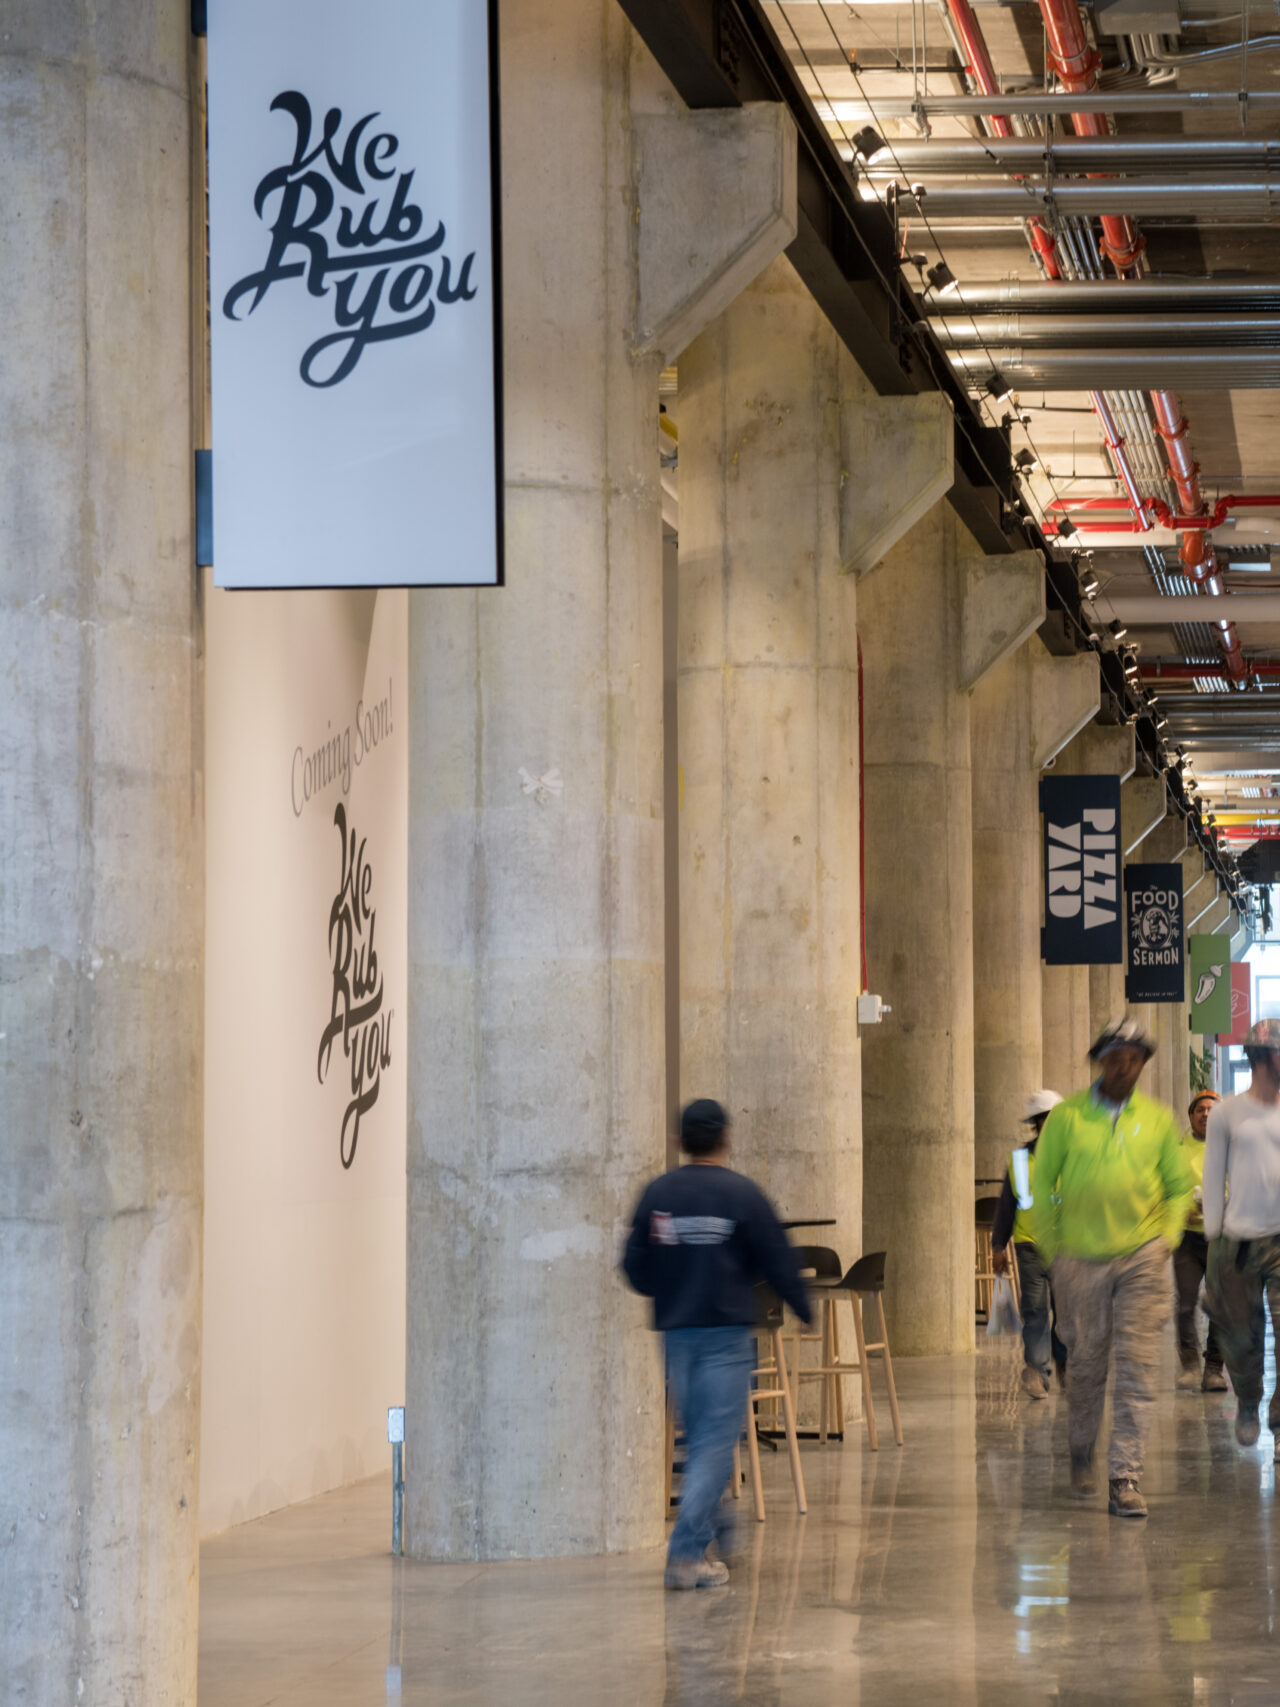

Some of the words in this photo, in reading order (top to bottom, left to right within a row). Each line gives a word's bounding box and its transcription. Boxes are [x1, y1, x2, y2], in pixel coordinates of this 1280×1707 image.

[269, 90, 399, 195] We
[223, 165, 446, 321] Rub
[300, 251, 478, 388] you
[291, 720, 351, 818] Coming
[354, 678, 394, 767] Soon!
[334, 802, 373, 936] We
[1048, 822, 1082, 918] YARD
[1083, 808, 1117, 930] PIZZA
[1131, 890, 1179, 913] FOOD
[318, 894, 384, 1085] Rub
[1133, 947, 1180, 966] SERMON
[341, 1010, 393, 1170] you
